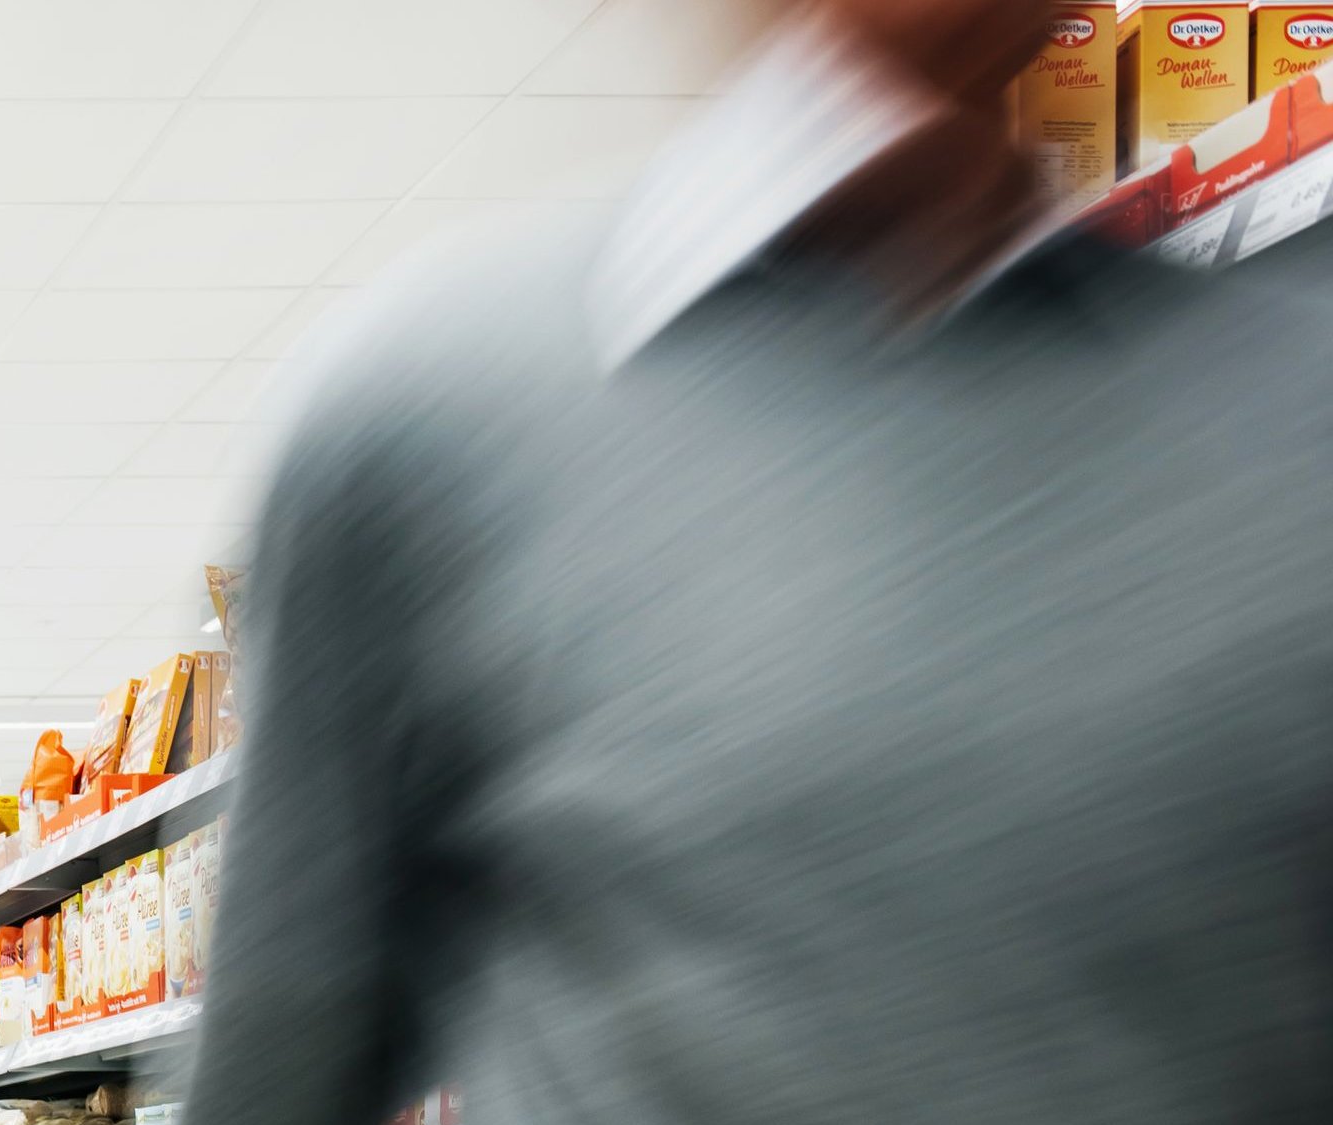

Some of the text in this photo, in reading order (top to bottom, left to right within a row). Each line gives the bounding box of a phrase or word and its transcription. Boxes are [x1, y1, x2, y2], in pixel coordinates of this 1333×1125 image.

[1059, 23, 1091, 34] Oetker
[1185, 23, 1220, 34] Oetker
[1302, 24, 1333, 35] Oetke
[1032, 54, 1088, 75] Donau-
[1156, 57, 1216, 76] Donau-
[1055, 69, 1098, 87] Wellen
[1181, 71, 1228, 88] Wellen
[137, 894, 158, 921] Püree
